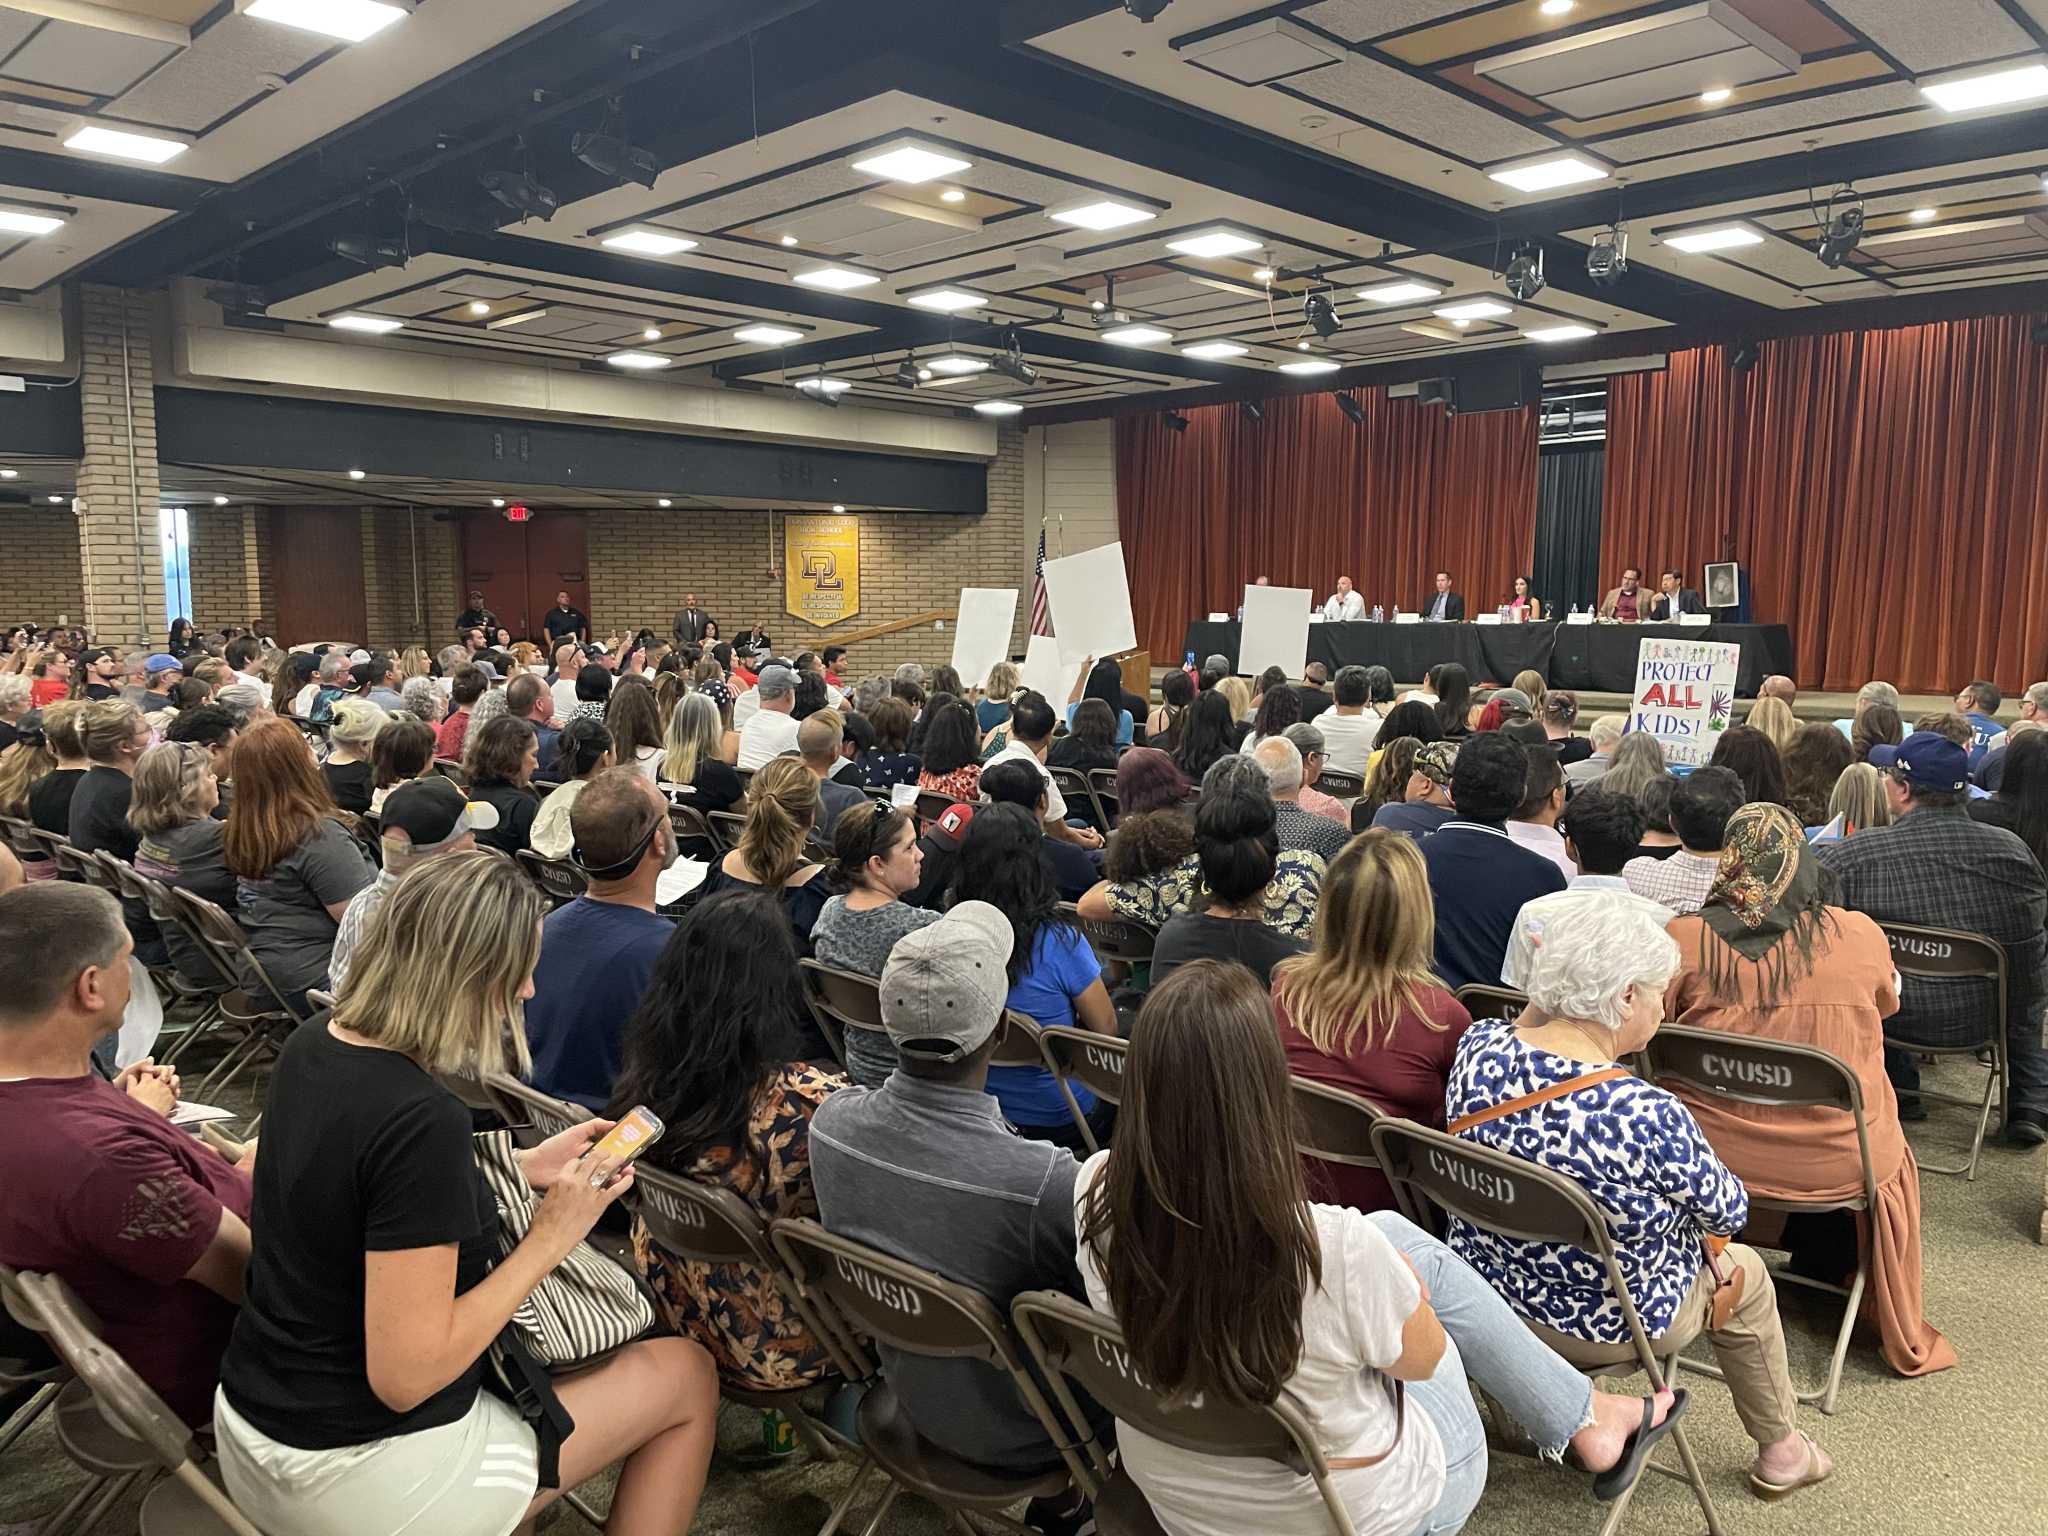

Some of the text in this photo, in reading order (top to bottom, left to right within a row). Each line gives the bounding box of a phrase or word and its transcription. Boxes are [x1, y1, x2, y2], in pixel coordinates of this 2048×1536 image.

[1641, 662, 1715, 682] PROTECT
[1640, 683, 1703, 710] ALL
[1637, 712, 1701, 737] KIDS!
[1086, 1045, 1126, 1074] CVU
[1702, 1053, 1792, 1088] CVUSD
[1429, 1149, 1515, 1204] CVUSD
[642, 1181, 706, 1229] CVUSD
[836, 1254, 922, 1316] CVUSD
